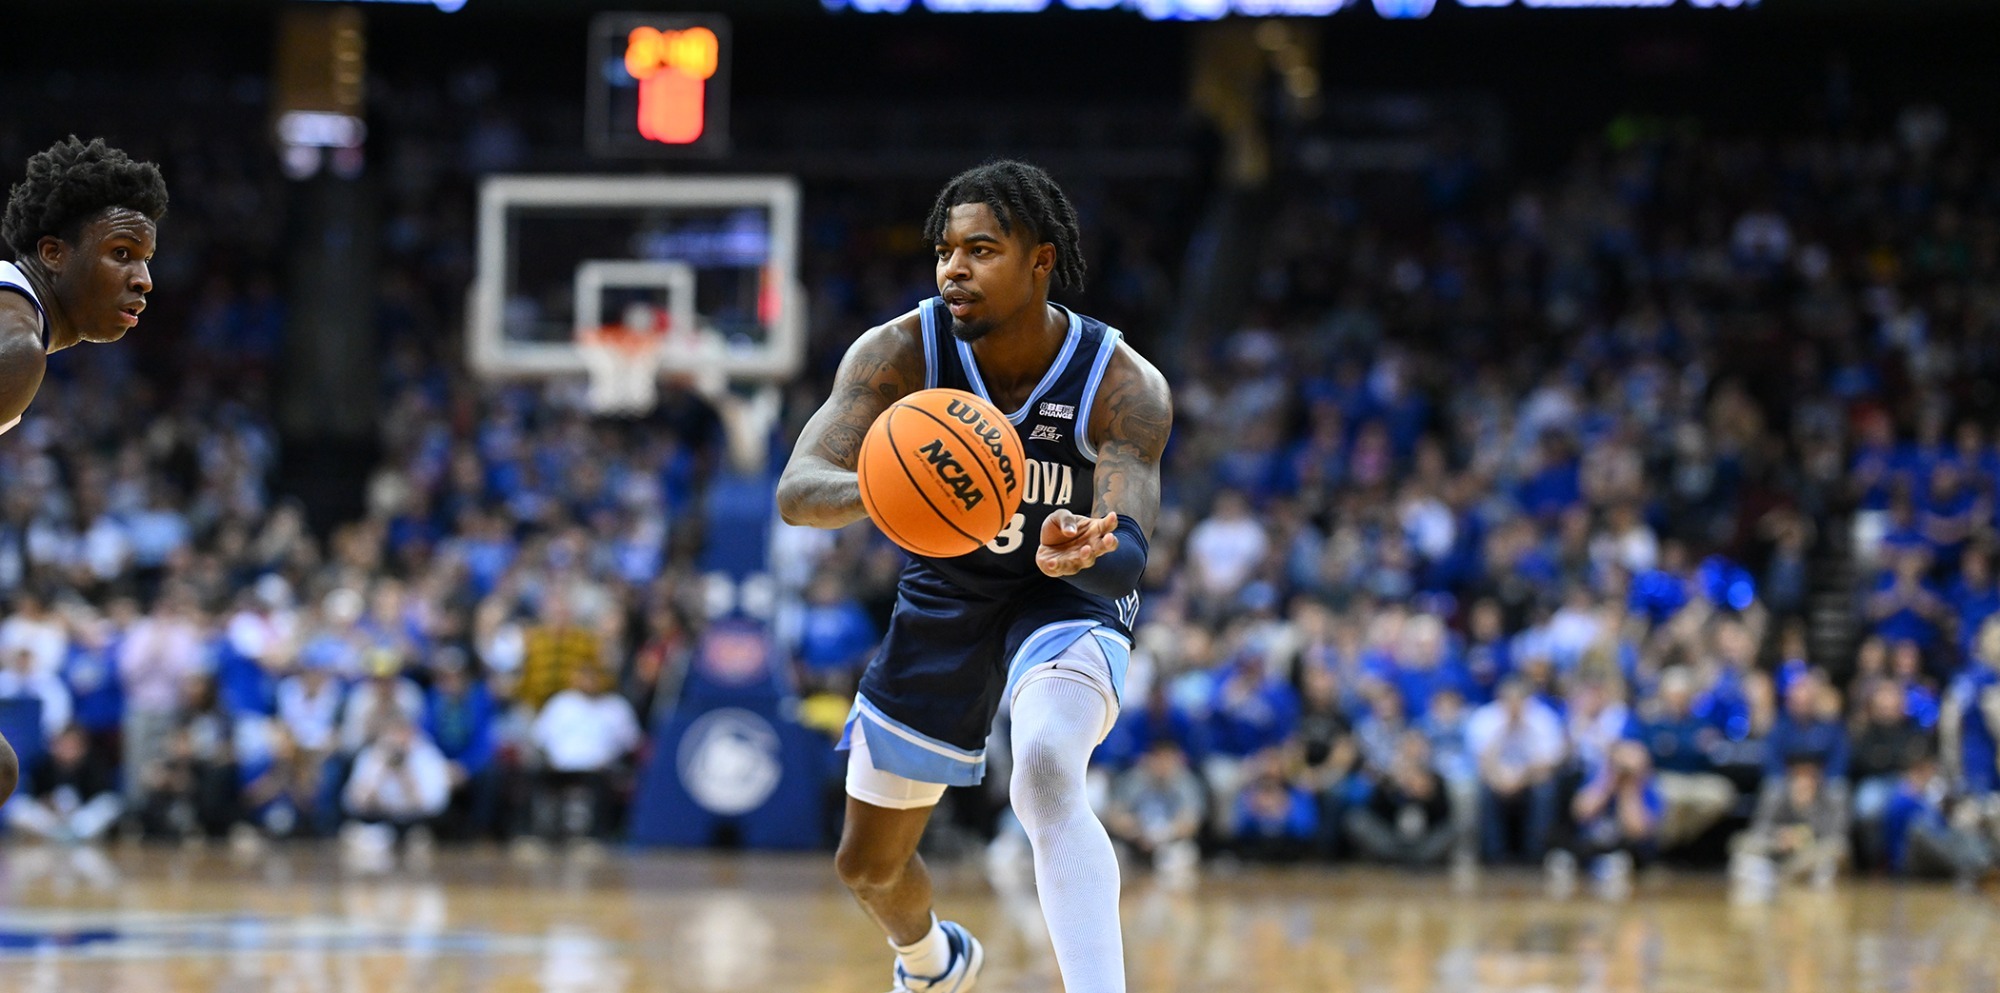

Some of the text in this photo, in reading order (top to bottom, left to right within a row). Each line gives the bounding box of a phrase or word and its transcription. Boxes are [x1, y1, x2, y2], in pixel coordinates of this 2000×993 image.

[1035, 424, 1057, 433] BIG
[1039, 410, 1073, 419] CHANGE
[946, 398, 1017, 497] Wilson
[1031, 430, 1063, 440] EAST
[919, 438, 984, 511] NCAA
[1022, 458, 1073, 506] OVA
